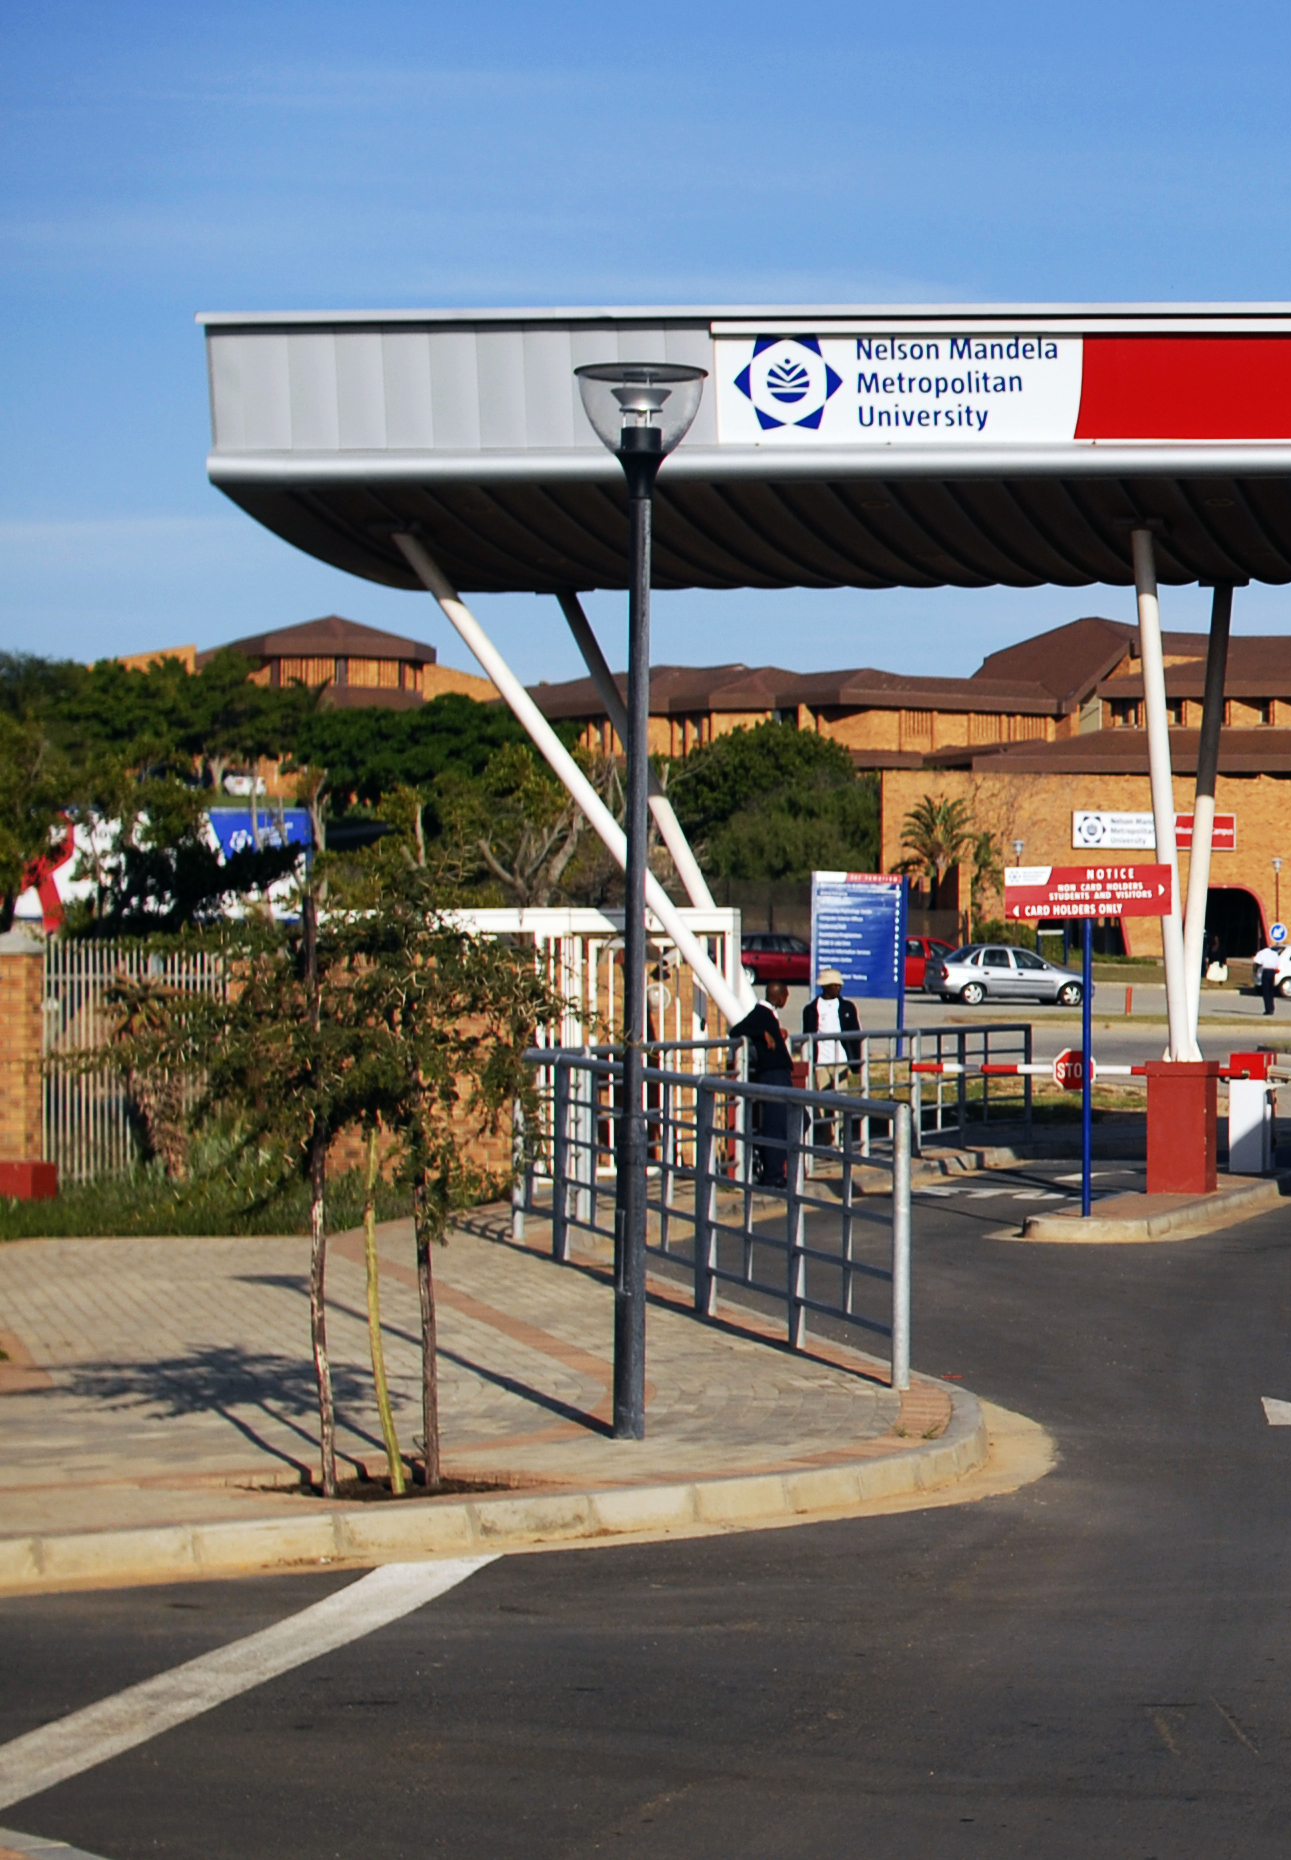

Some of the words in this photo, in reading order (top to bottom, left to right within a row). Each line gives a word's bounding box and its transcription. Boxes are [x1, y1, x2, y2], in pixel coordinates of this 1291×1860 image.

[856, 337, 939, 360] Nelson
[950, 337, 1058, 360] Mandela
[857, 371, 1023, 398] Metropolitan
[859, 404, 989, 431] University
[1086, 868, 1135, 880] NOTICE
[1057, 884, 1077, 892] NON
[1080, 883, 1103, 892] CARD
[1106, 882, 1144, 891] HOLDERS
[1049, 892, 1090, 901] STUDENTS
[1094, 891, 1112, 900] AND
[1116, 890, 1153, 899] VISITORS
[1024, 905, 1050, 917] CARD
[1053, 904, 1096, 916] HOLDERS
[1099, 903, 1123, 915] ONLY
[1057, 1062, 1083, 1079] STO
